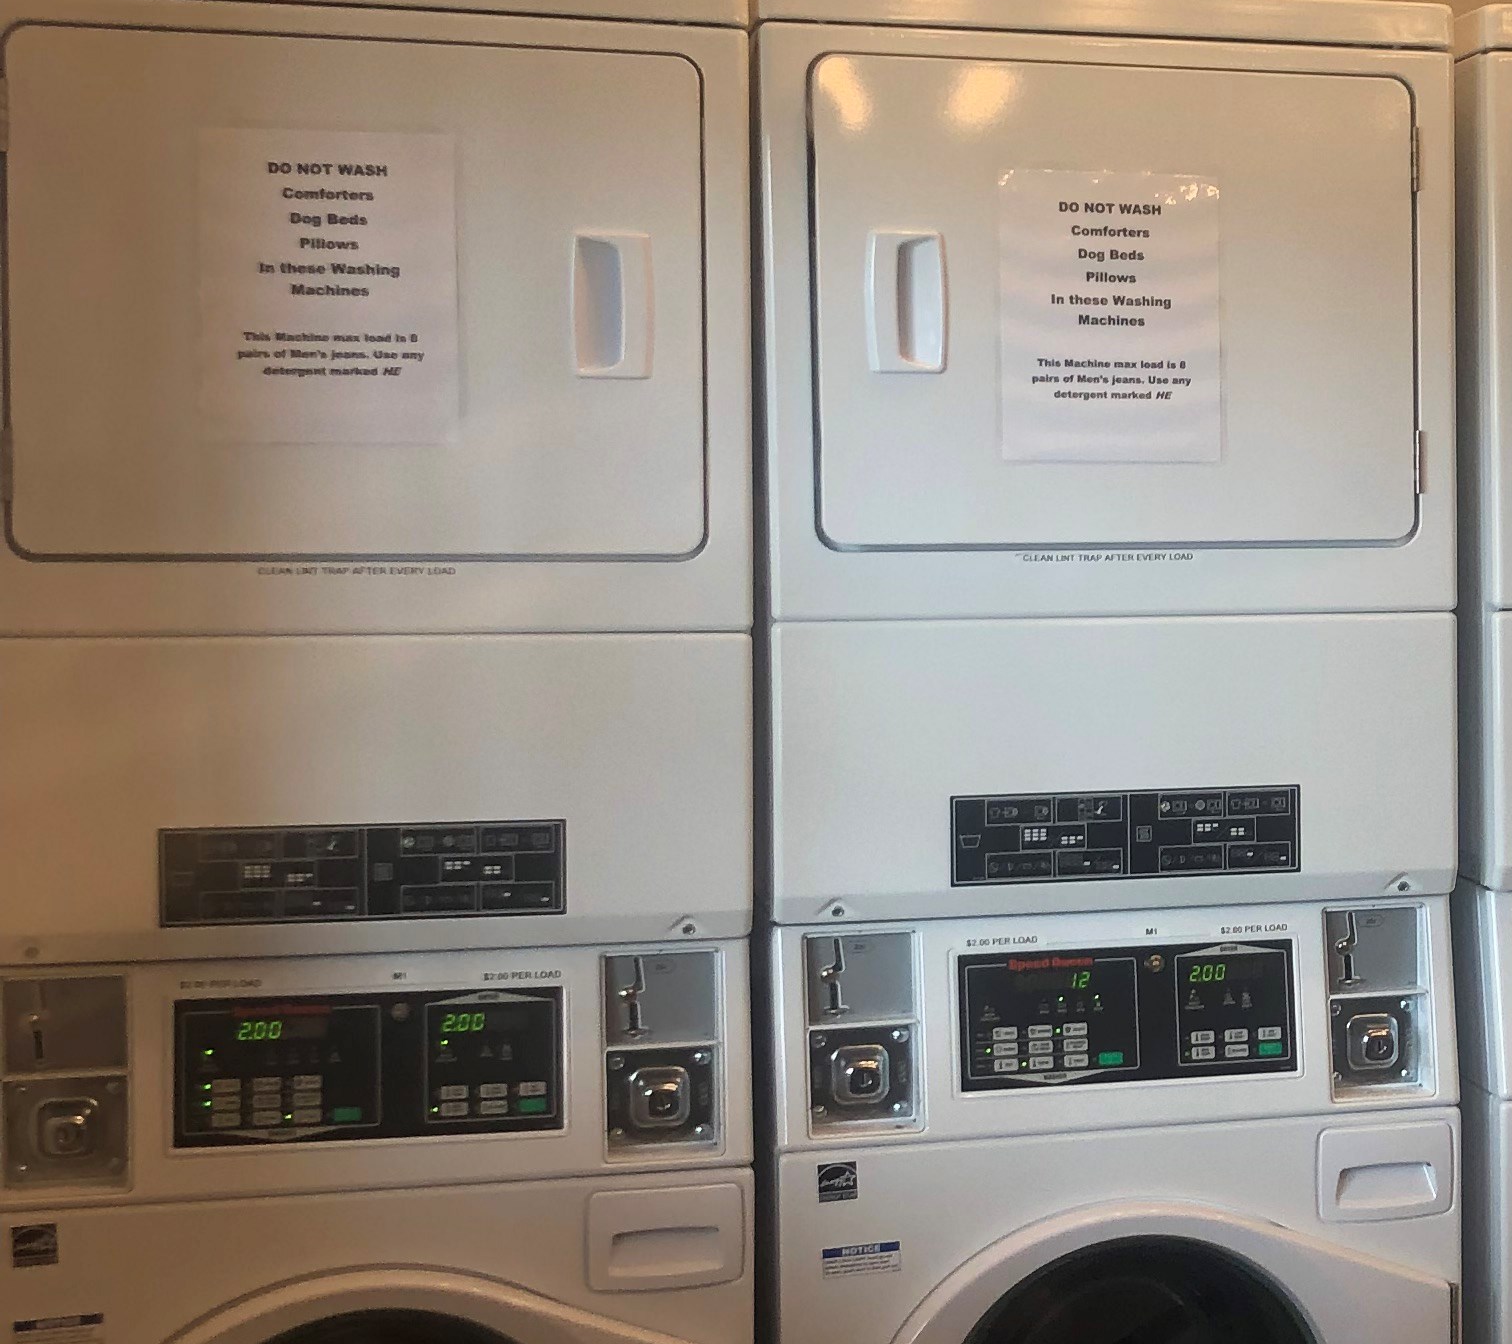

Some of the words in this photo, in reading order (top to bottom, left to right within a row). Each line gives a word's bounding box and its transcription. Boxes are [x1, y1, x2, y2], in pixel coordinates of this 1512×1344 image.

[268, 161, 292, 175] DO
[297, 162, 333, 176] NOT
[338, 163, 388, 177] WASH
[282, 187, 374, 201] Comforters
[1059, 201, 1080, 213] DO
[1084, 202, 1115, 214] NOT
[1119, 203, 1162, 216] WASH
[290, 212, 321, 227] Dog
[327, 213, 368, 226] Beds
[1071, 225, 1150, 238] Comforters
[300, 237, 359, 250] Pillows
[1078, 248, 1105, 262] Dog
[1109, 249, 1145, 261] Beds
[259, 261, 275, 274] In
[280, 262, 326, 275] these
[331, 262, 400, 278] Washing
[1086, 271, 1137, 283] Pillows
[291, 284, 369, 297] Machines
[1051, 293, 1065, 305] In
[1069, 294, 1108, 306] these
[1112, 295, 1172, 310] Washing
[1078, 314, 1145, 327] Machines
[275, 332, 330, 342] Machine
[1037, 358, 1061, 367] This
[1064, 359, 1111, 369] Machine
[1114, 361, 1137, 369] max
[1141, 360, 1163, 369] load
[1167, 360, 1176, 369] is
[1031, 374, 1059, 384] pairs
[1063, 374, 1074, 383] of
[1077, 374, 1109, 384] Men's
[1112, 375, 1145, 385] jeans.
[1148, 375, 1168, 384] Use
[1172, 377, 1191, 386] any
[1054, 390, 1108, 401] detergent
[1111, 390, 1151, 400] marked
[1155, 391, 1173, 400] HE
[1022, 554, 1053, 562] CLEAN
[1056, 554, 1074, 562] LINT
[1078, 554, 1100, 562] TRAP
[1104, 554, 1134, 562] AFTER
[1136, 553, 1166, 561] EVERY
[1169, 552, 1193, 561] LOAD
[1245, 925, 1262, 933] PER
[1264, 924, 1288, 932] LOAD
[992, 937, 1010, 945] PER
[1013, 936, 1038, 944] LOAD
[511, 971, 532, 980] PER
[534, 970, 562, 979] LOAD
[1072, 971, 1091, 989] 12
[842, 1246, 880, 1257] NOTICE
